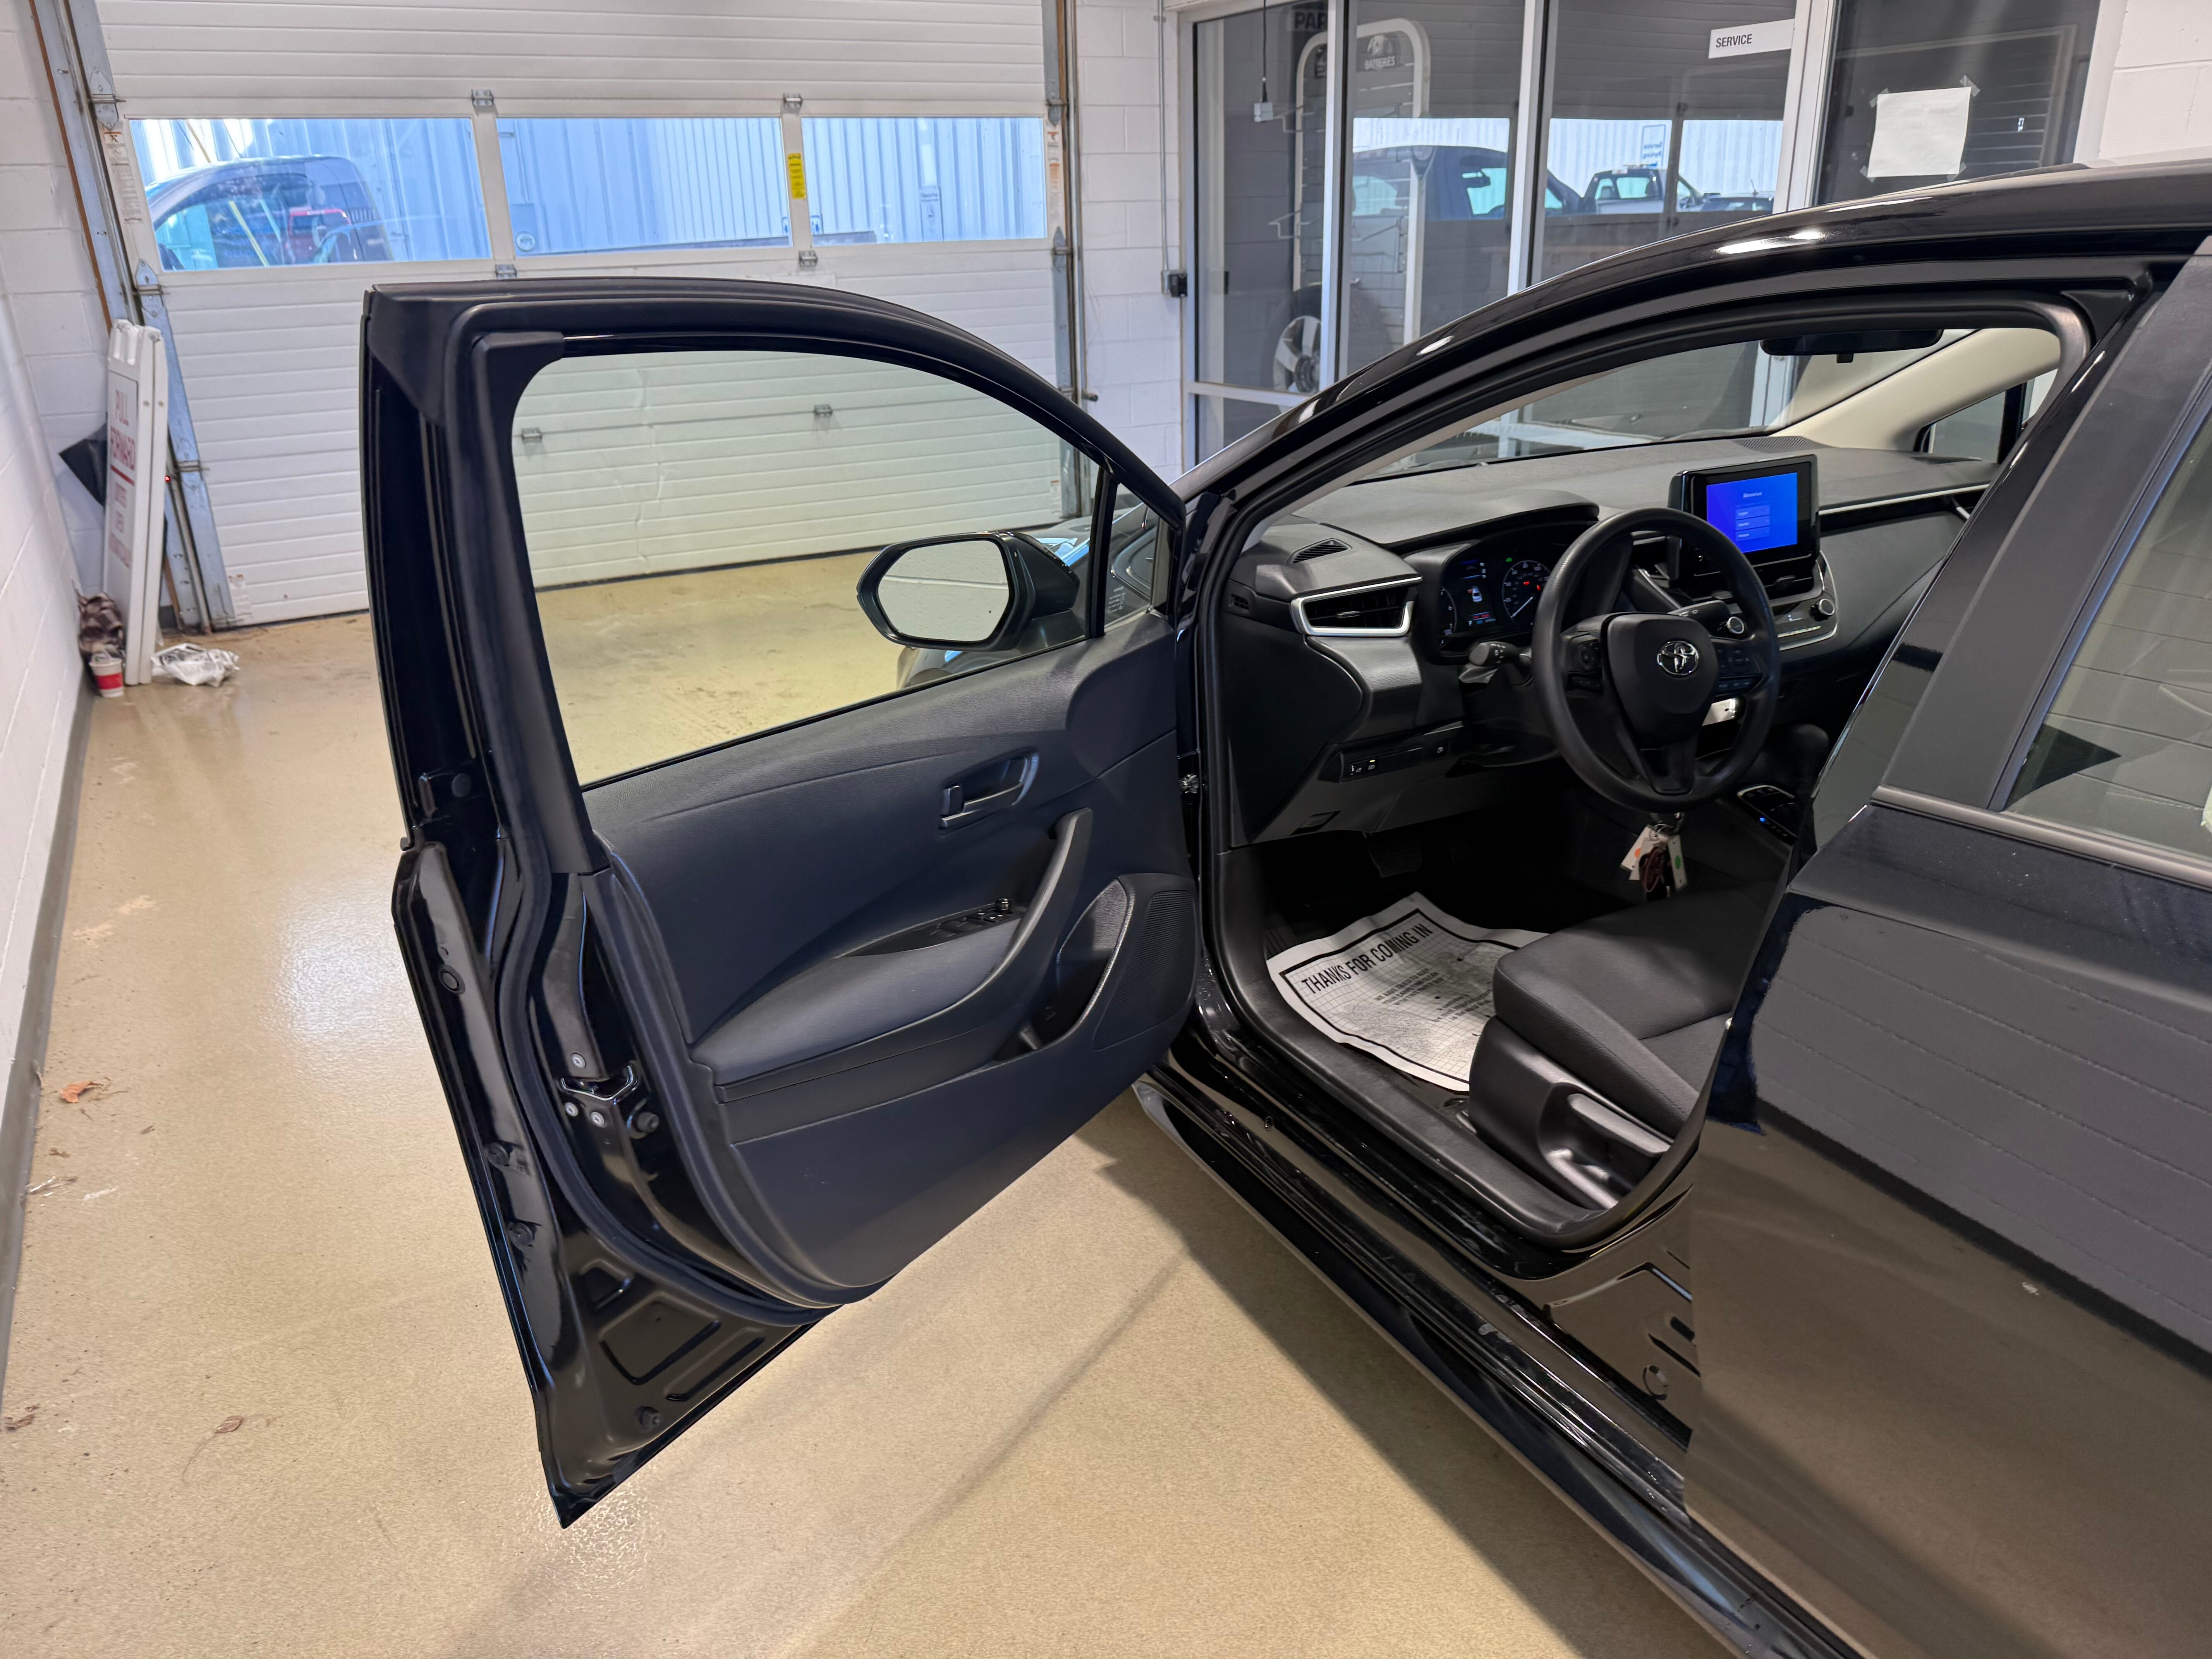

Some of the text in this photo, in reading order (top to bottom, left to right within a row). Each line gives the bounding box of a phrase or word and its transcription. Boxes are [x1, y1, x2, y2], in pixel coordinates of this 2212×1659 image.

[1295, 12, 1328, 29] PAR
[1716, 34, 1752, 48] SERVICE
[1365, 56, 1395, 70] BATTERIES
[1302, 923, 1433, 994] THANKS FOR COMING IN
